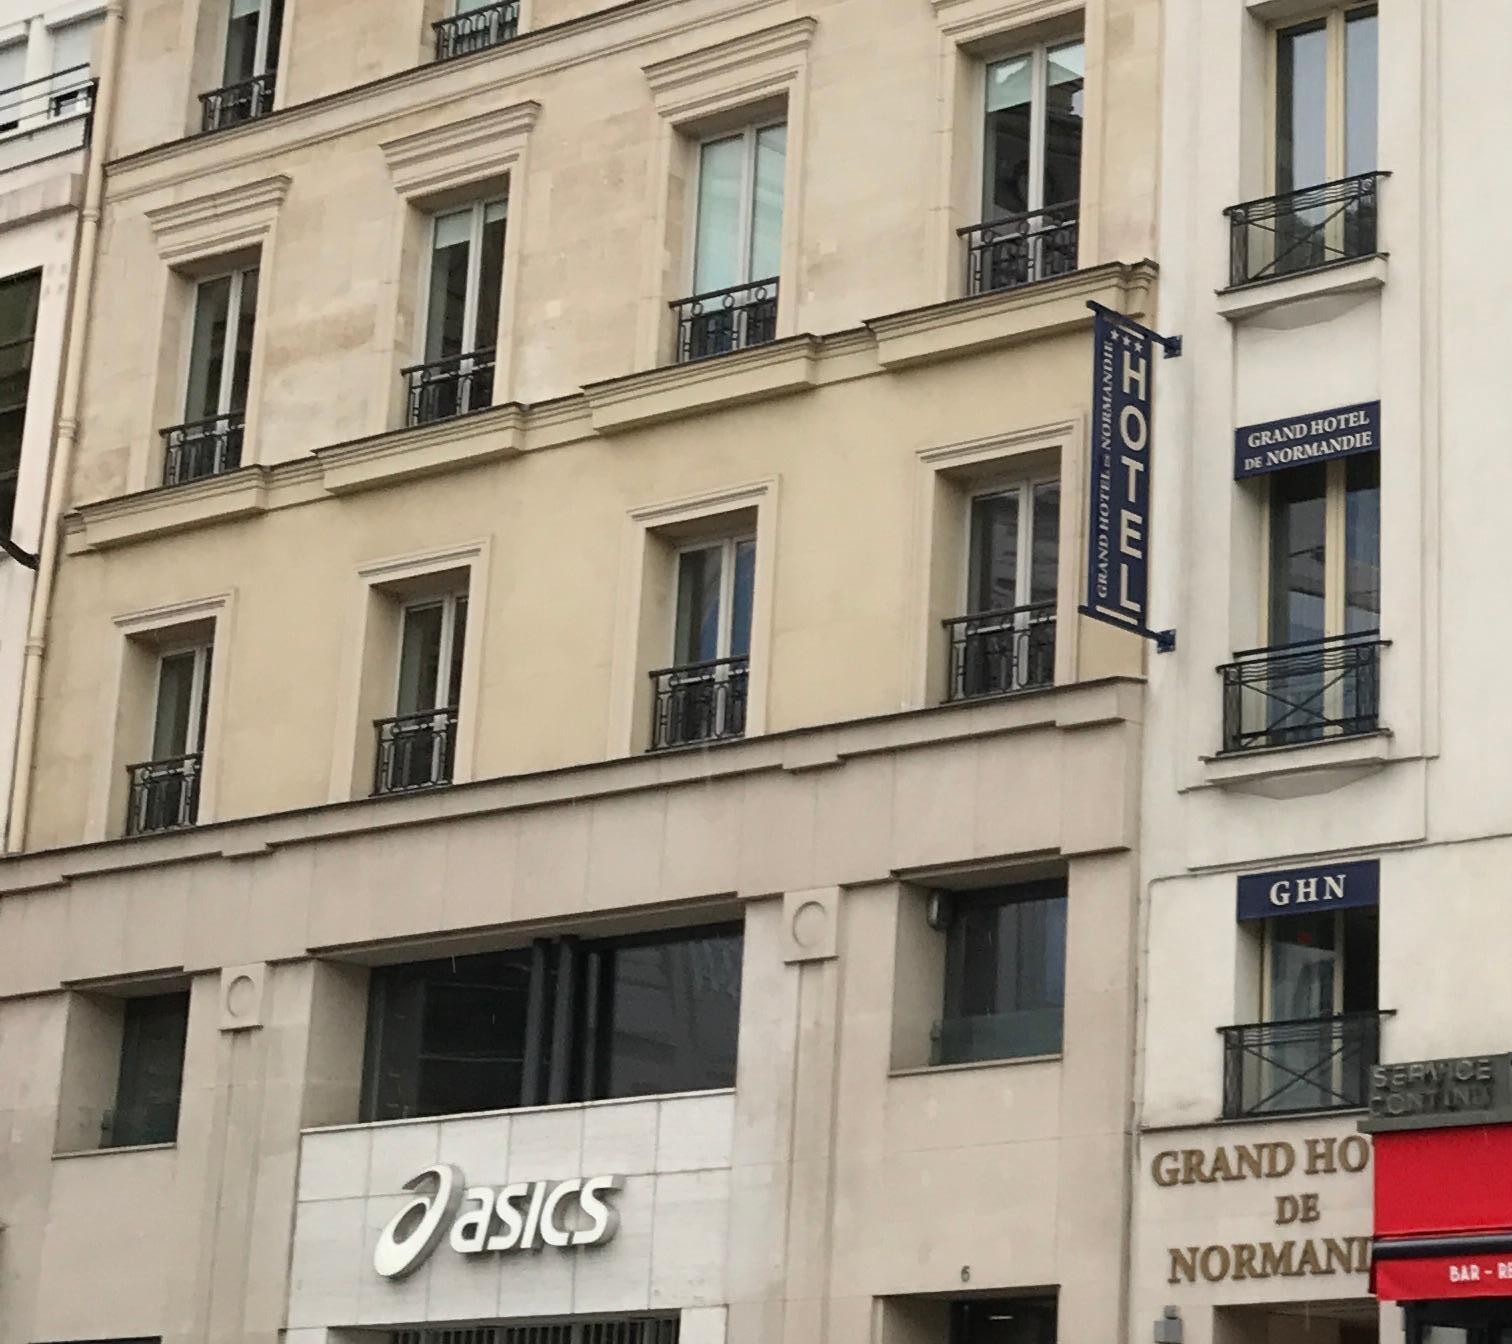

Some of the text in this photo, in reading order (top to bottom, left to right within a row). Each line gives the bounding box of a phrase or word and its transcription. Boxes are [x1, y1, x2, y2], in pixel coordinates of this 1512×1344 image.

[1101, 340, 1114, 450] NORMANDIE
[1247, 410, 1370, 448] GRAND HOTEL
[1244, 431, 1372, 471] DE NORMANDIE
[1099, 470, 1111, 531] HOTEL
[1119, 350, 1147, 613] HOTEL
[1098, 534, 1110, 598] GRAND
[1269, 873, 1347, 907] GHN
[1151, 1135, 1371, 1187] GRAND HO
[1274, 1192, 1321, 1225] DE
[961, 1265, 970, 1283] 6
[1449, 1264, 1480, 1282] BAR
